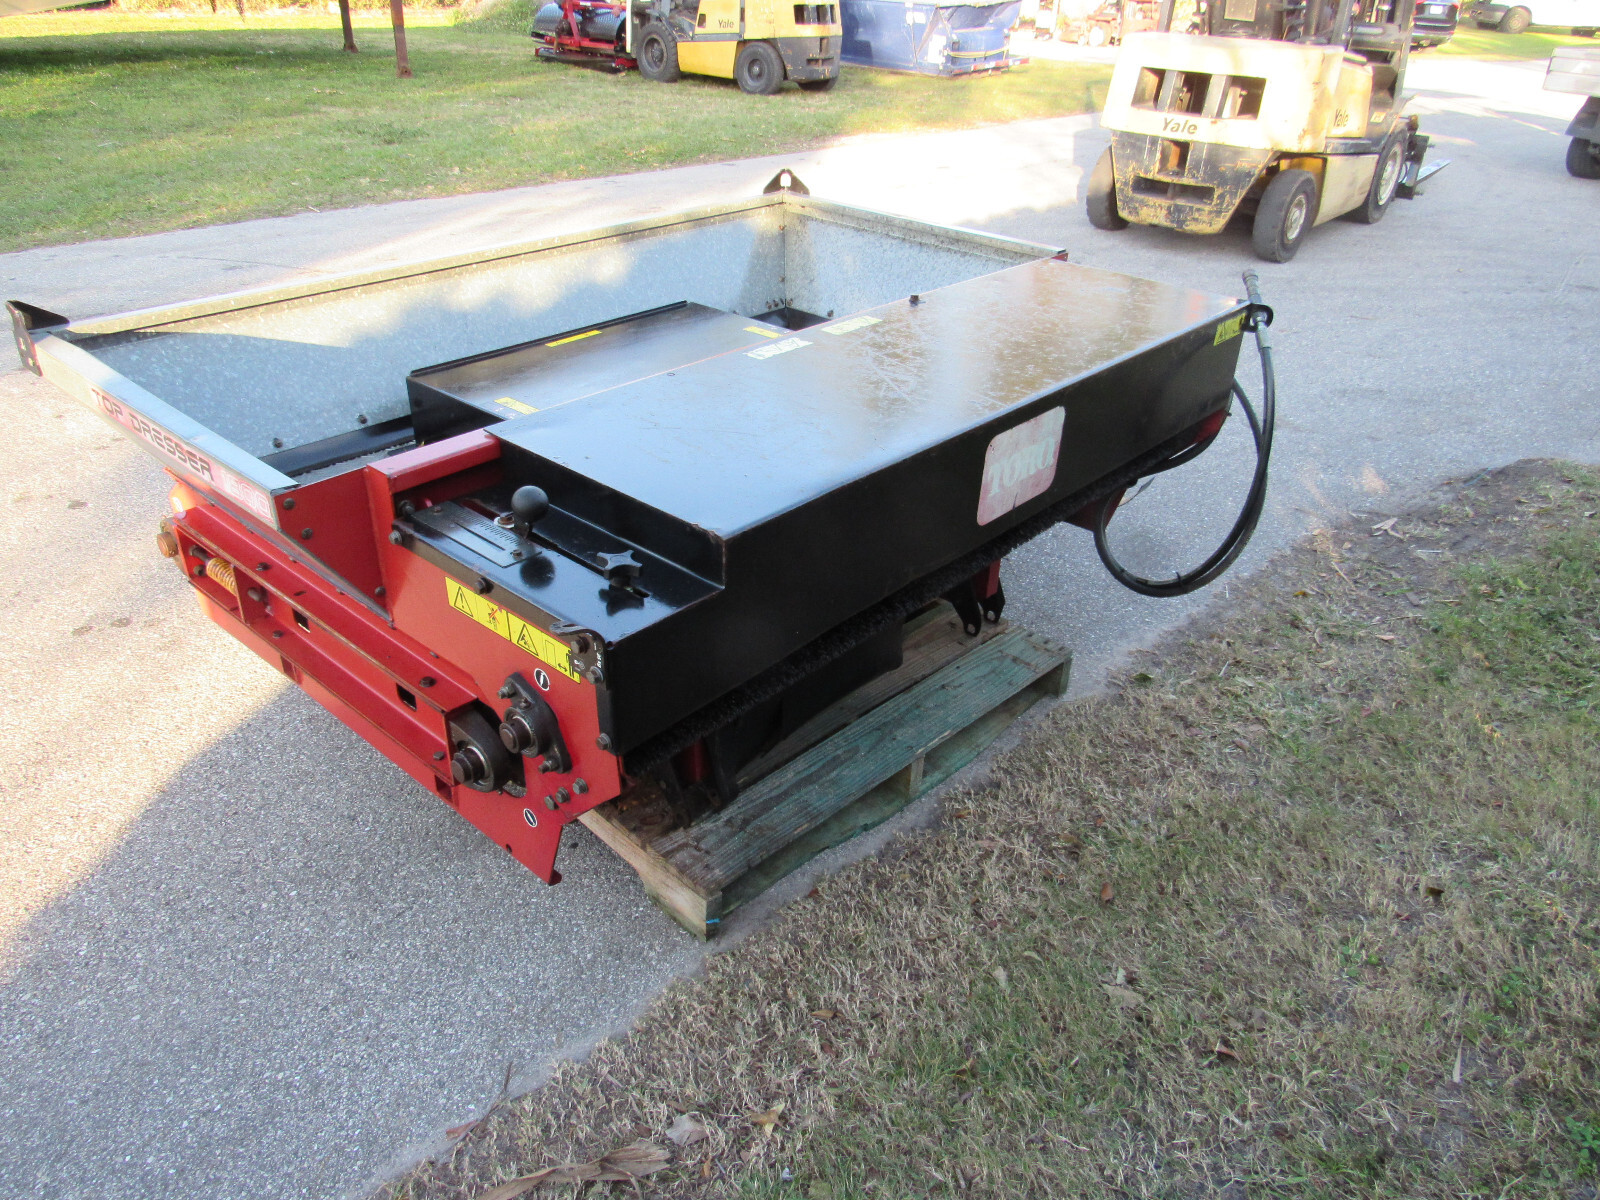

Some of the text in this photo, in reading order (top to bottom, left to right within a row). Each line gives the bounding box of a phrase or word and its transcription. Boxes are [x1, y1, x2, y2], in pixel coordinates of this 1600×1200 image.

[718, 19, 735, 28] Yale
[1162, 117, 1198, 135] Yale
[1333, 108, 1349, 127] Yale
[91, 388, 124, 418] TOP
[128, 412, 214, 482] DRESSER
